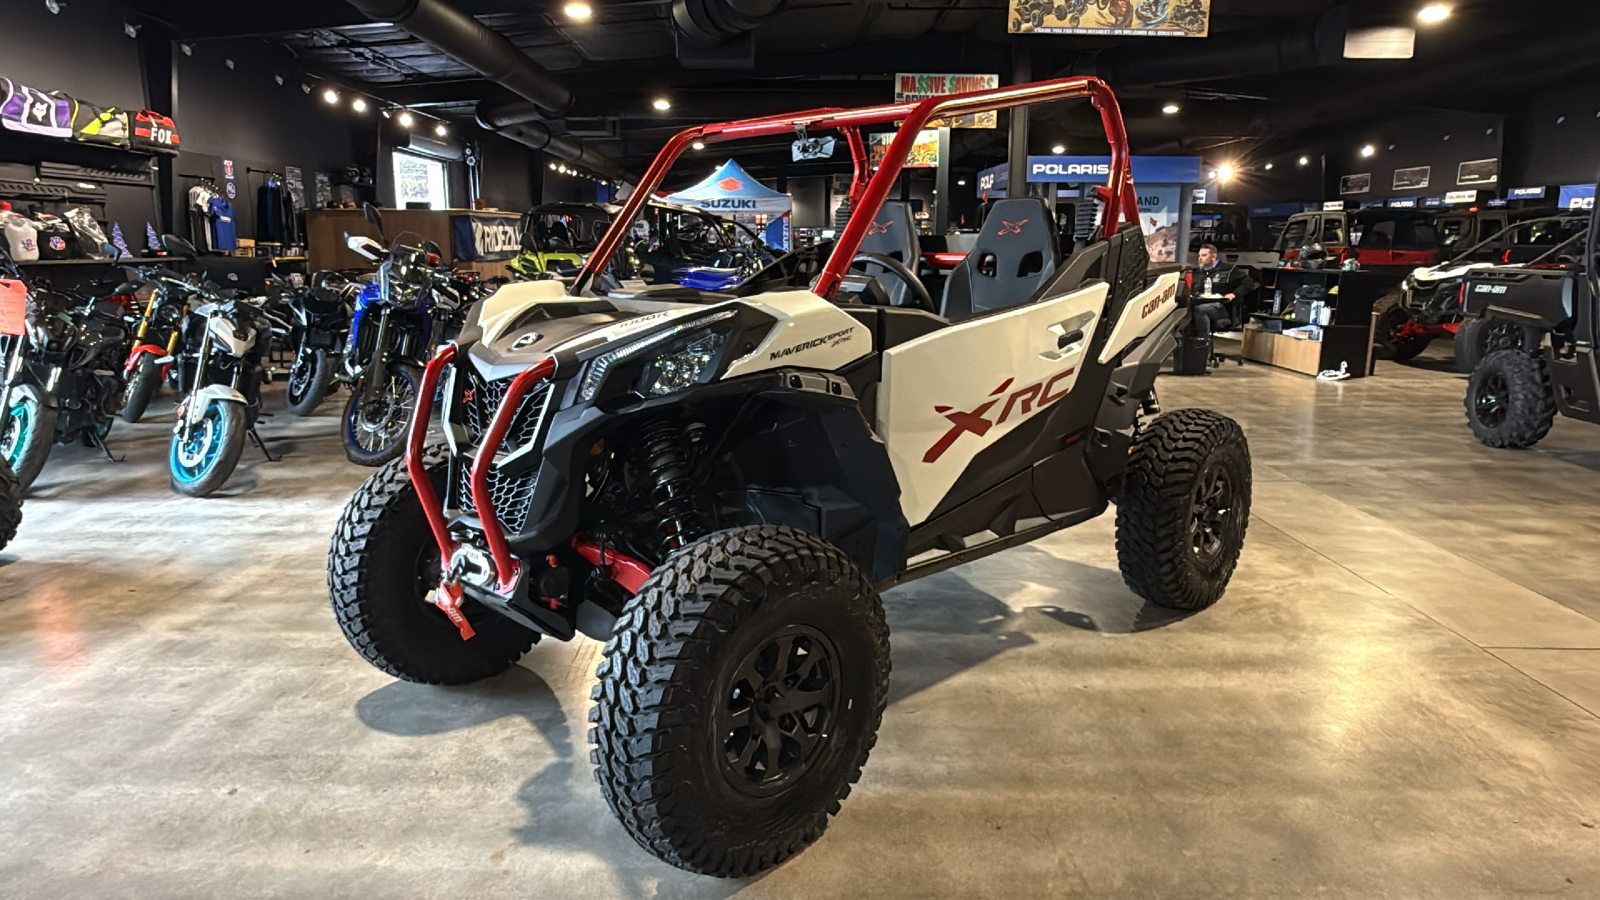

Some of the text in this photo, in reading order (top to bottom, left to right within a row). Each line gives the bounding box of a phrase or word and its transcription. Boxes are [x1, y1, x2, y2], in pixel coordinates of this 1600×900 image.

[151, 127, 172, 144] FOX
[1032, 164, 1109, 174] POLARIS
[700, 199, 756, 209] SUZUKI
[1474, 284, 1508, 294] can-am
[1142, 282, 1176, 320] can-am
[769, 326, 856, 361] MAVERICK SPORT
